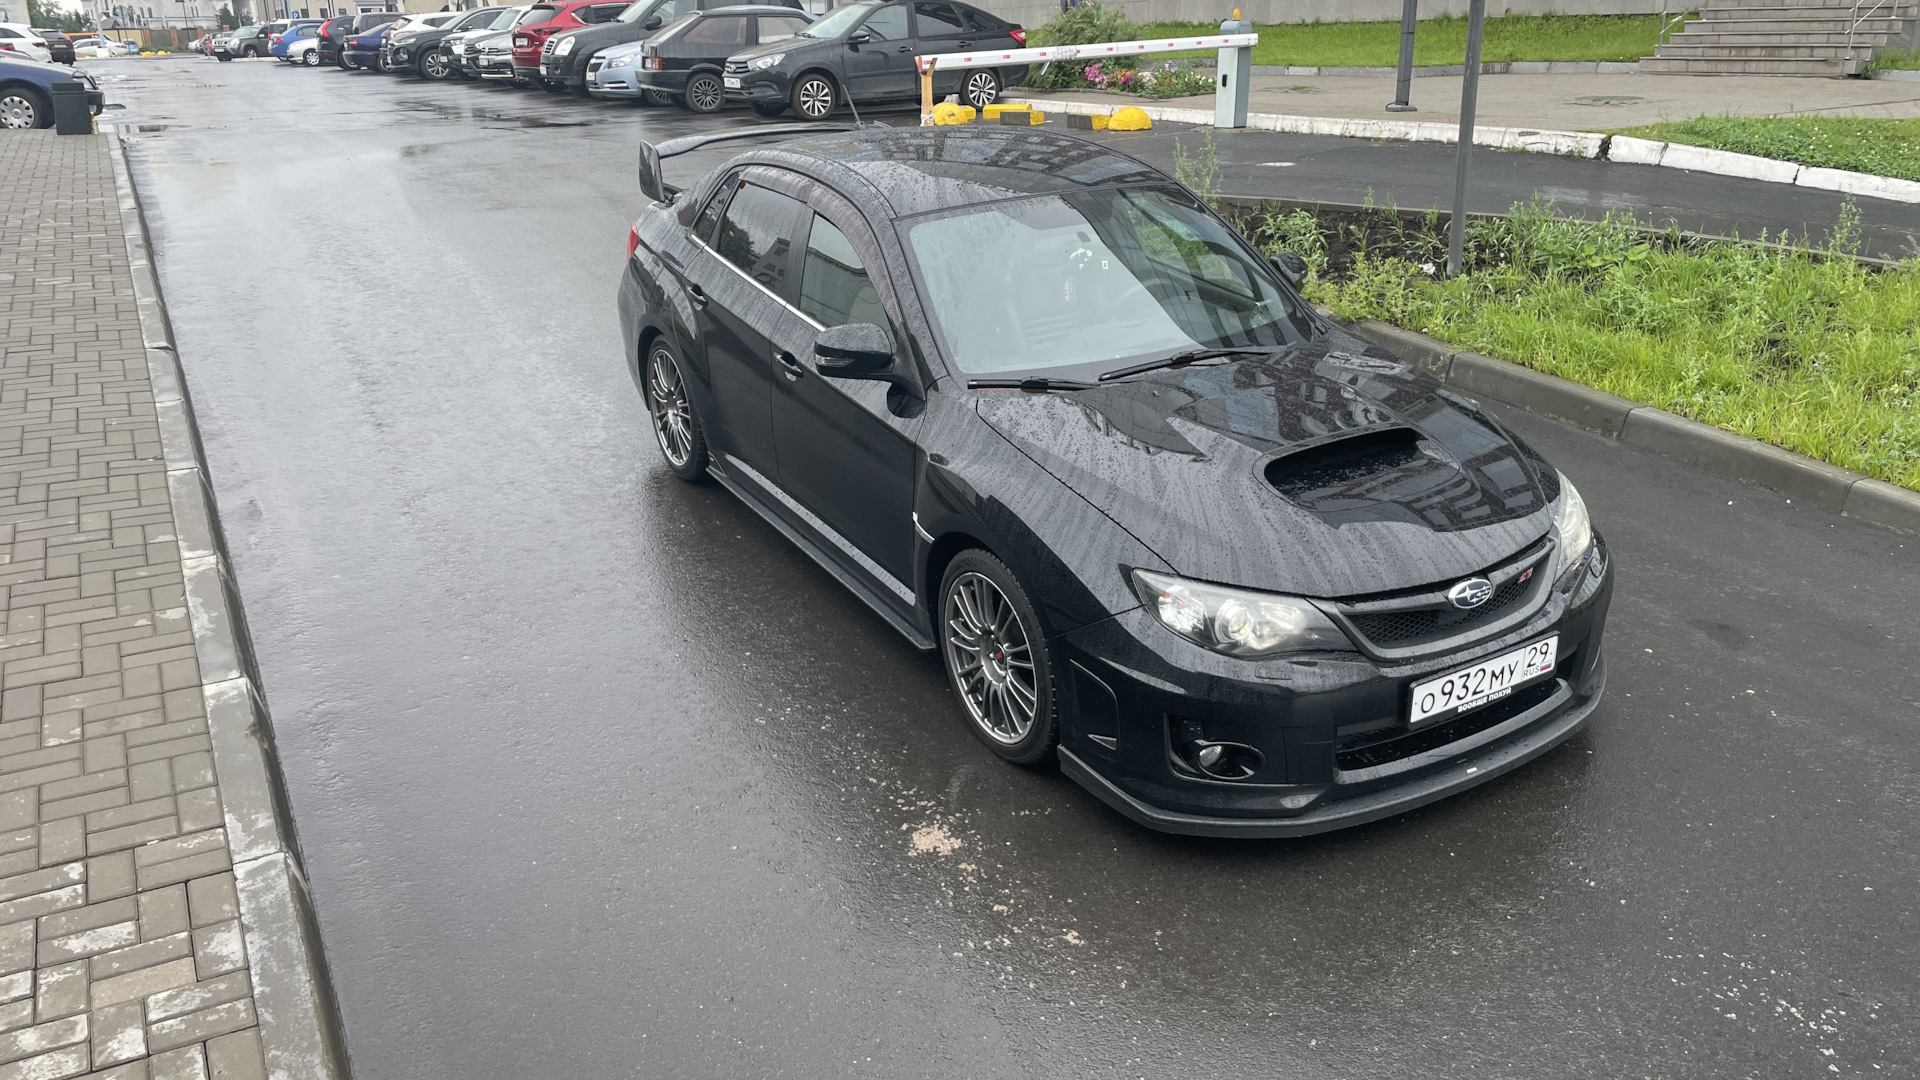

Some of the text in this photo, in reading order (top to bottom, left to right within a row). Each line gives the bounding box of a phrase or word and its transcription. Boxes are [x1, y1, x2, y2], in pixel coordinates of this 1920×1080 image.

[1526, 642, 1550, 669] 29
[1523, 665, 1540, 677] RUS
[1457, 686, 1512, 713] ВООБЩЕ ПОХУЙ
